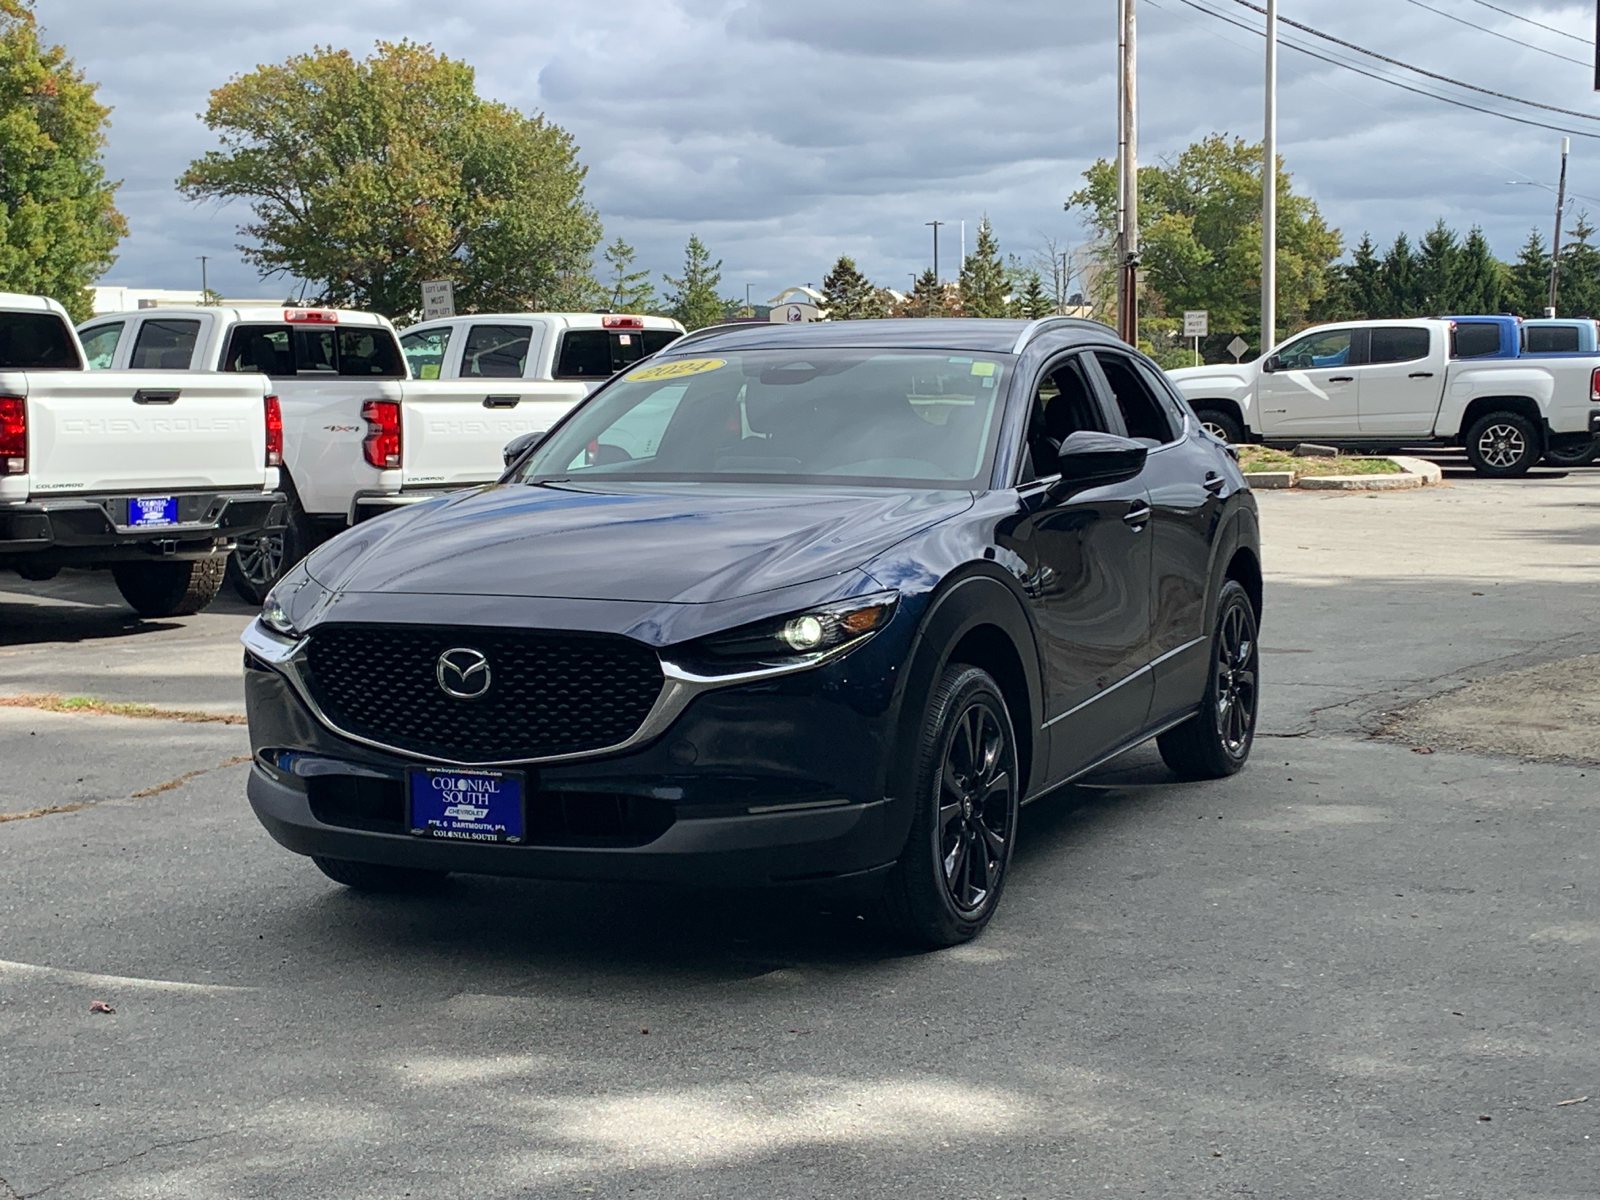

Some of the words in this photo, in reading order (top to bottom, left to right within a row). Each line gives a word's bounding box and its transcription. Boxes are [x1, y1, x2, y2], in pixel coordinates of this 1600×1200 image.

[431, 296, 444, 304] MUST
[61, 417, 247, 435] CHEVROLET
[429, 419, 556, 435] CHEVROLE
[431, 777, 500, 793] COLONIAL
[442, 791, 489, 805] SOUTH
[448, 808, 485, 817] CHEVROLET
[452, 821, 494, 831] DARTMOUTH,
[433, 829, 471, 840] COLONIAL
[471, 832, 498, 841] SOUTH
